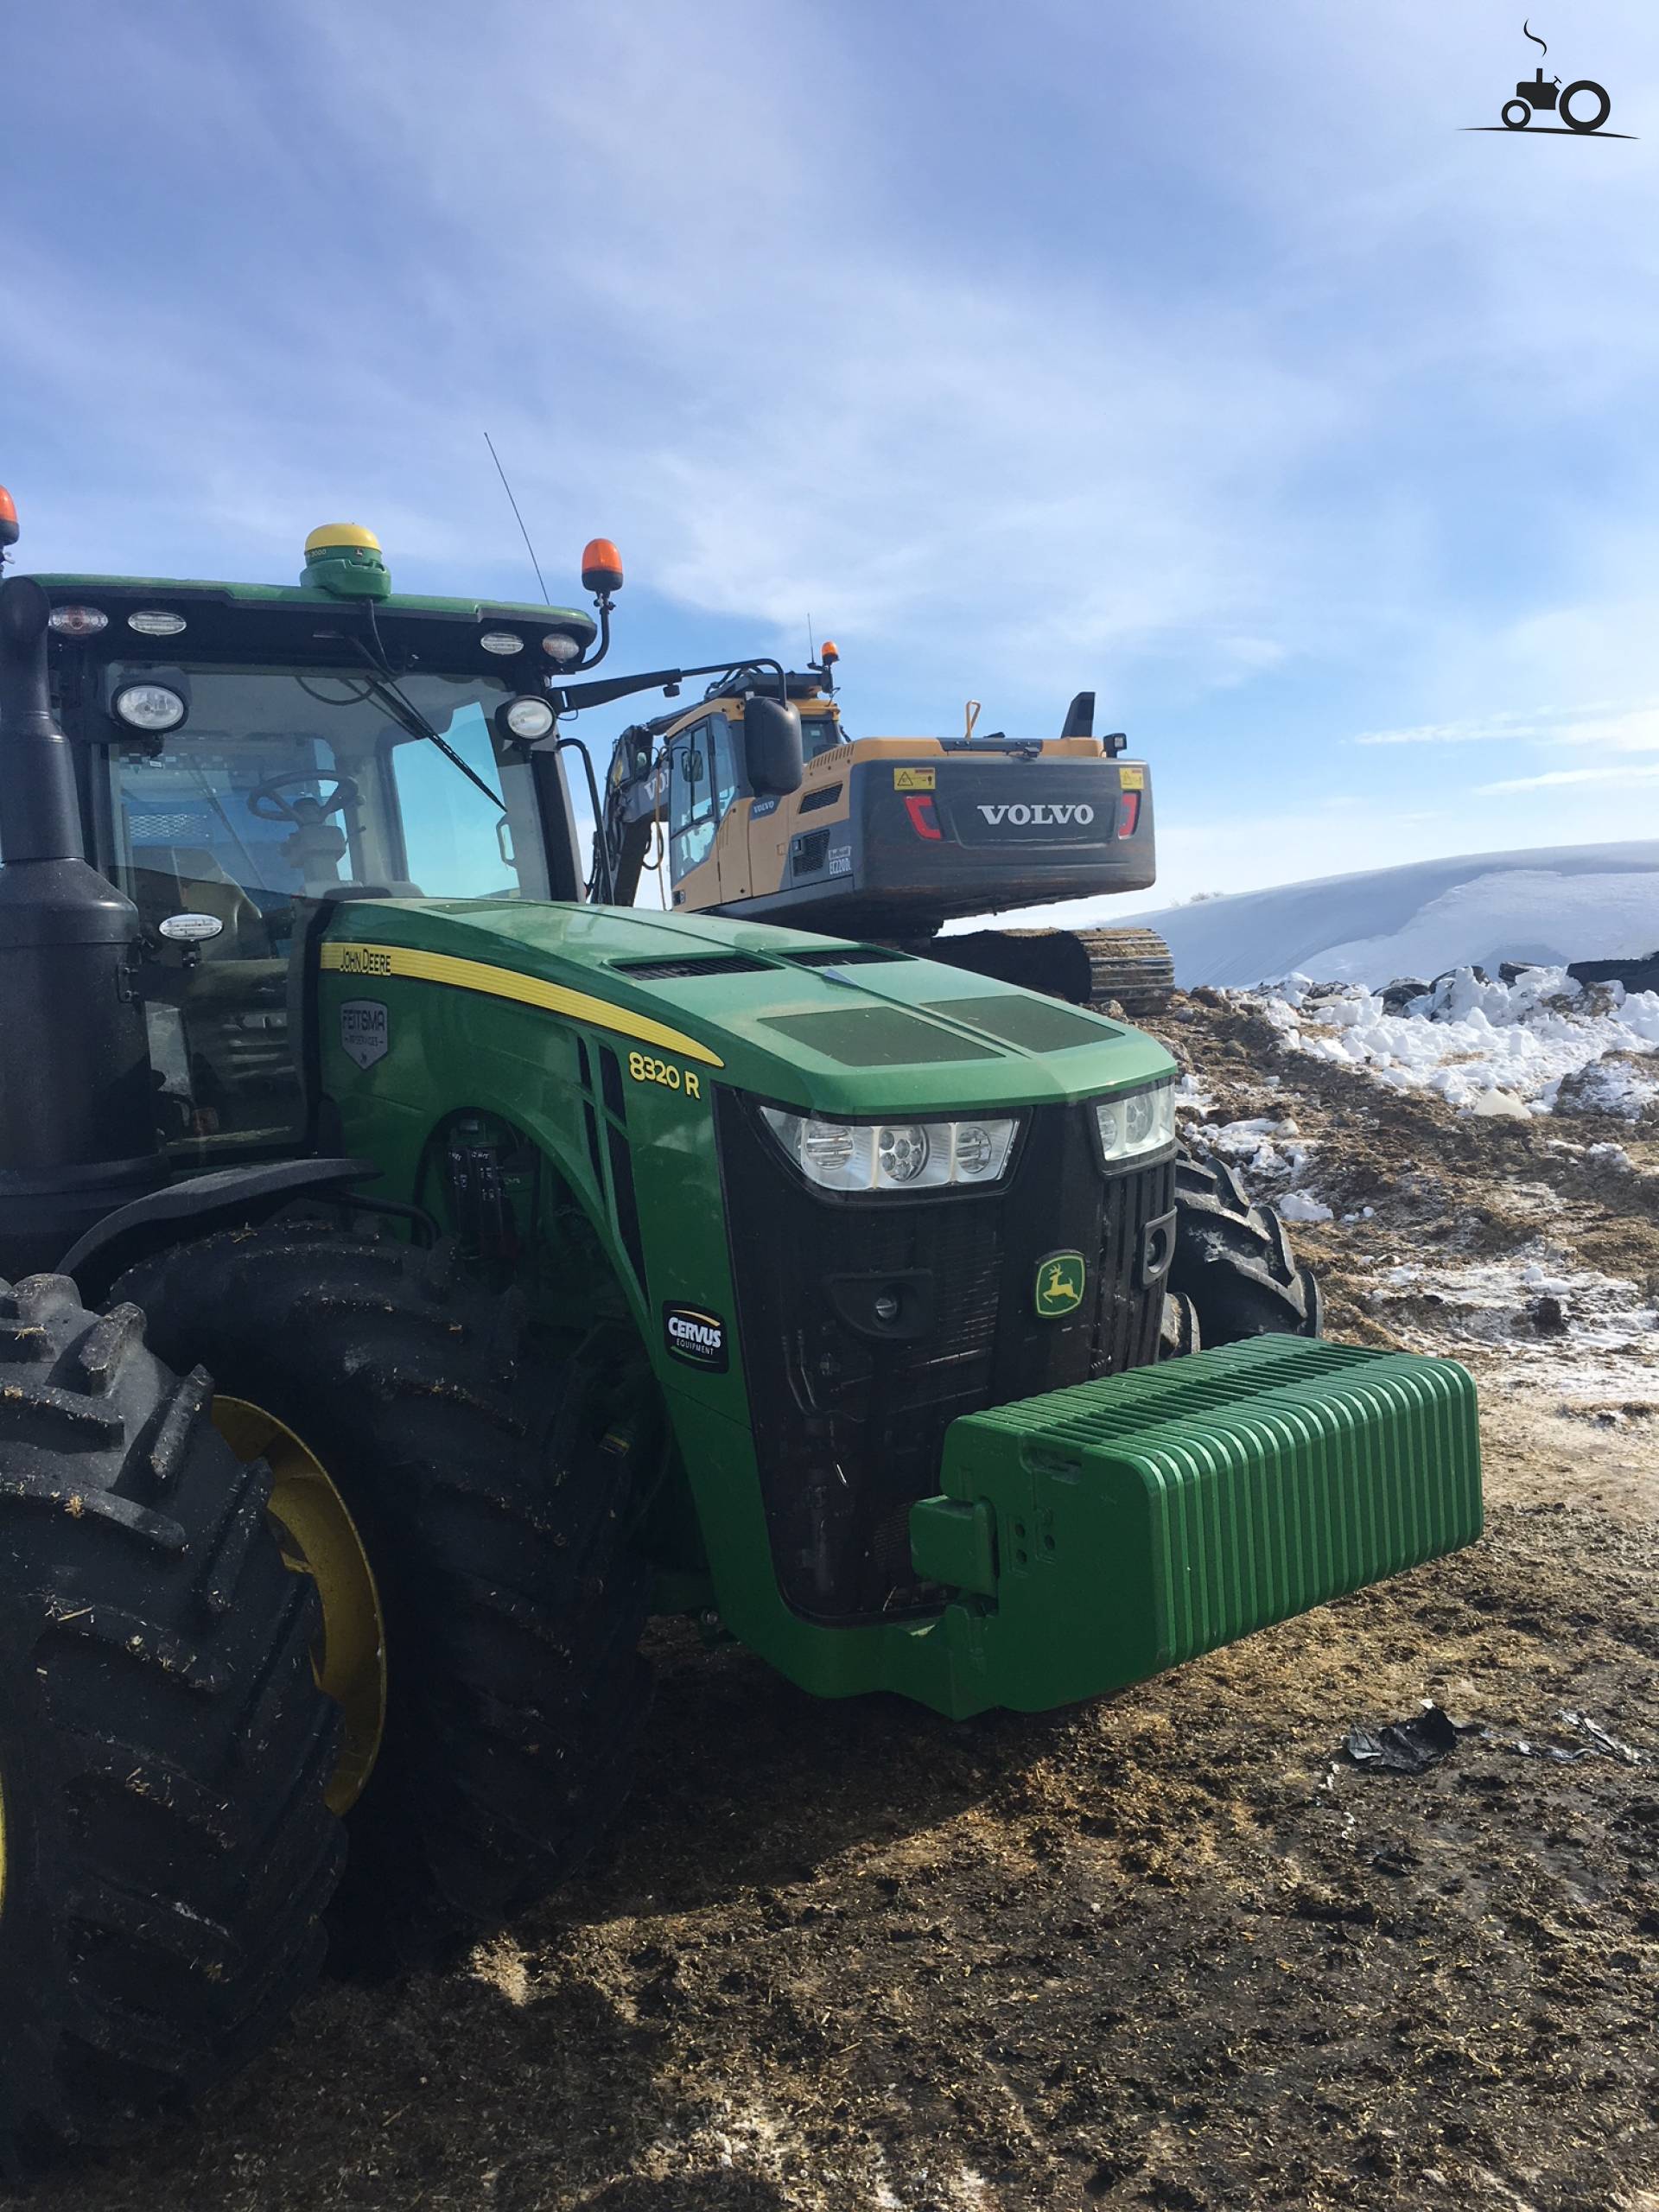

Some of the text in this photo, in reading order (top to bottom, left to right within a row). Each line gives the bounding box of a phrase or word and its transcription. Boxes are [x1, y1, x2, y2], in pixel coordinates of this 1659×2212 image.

[753, 800, 774, 813] VOLVO
[976, 804, 1095, 825] VOLVO
[340, 948, 391, 976] JOHN DEERE
[342, 1008, 385, 1031] FEITSMA
[629, 1052, 701, 1100] 8320 R
[668, 1316, 721, 1348] CERVUS
[676, 1338, 714, 1355] EQUIPMENT
